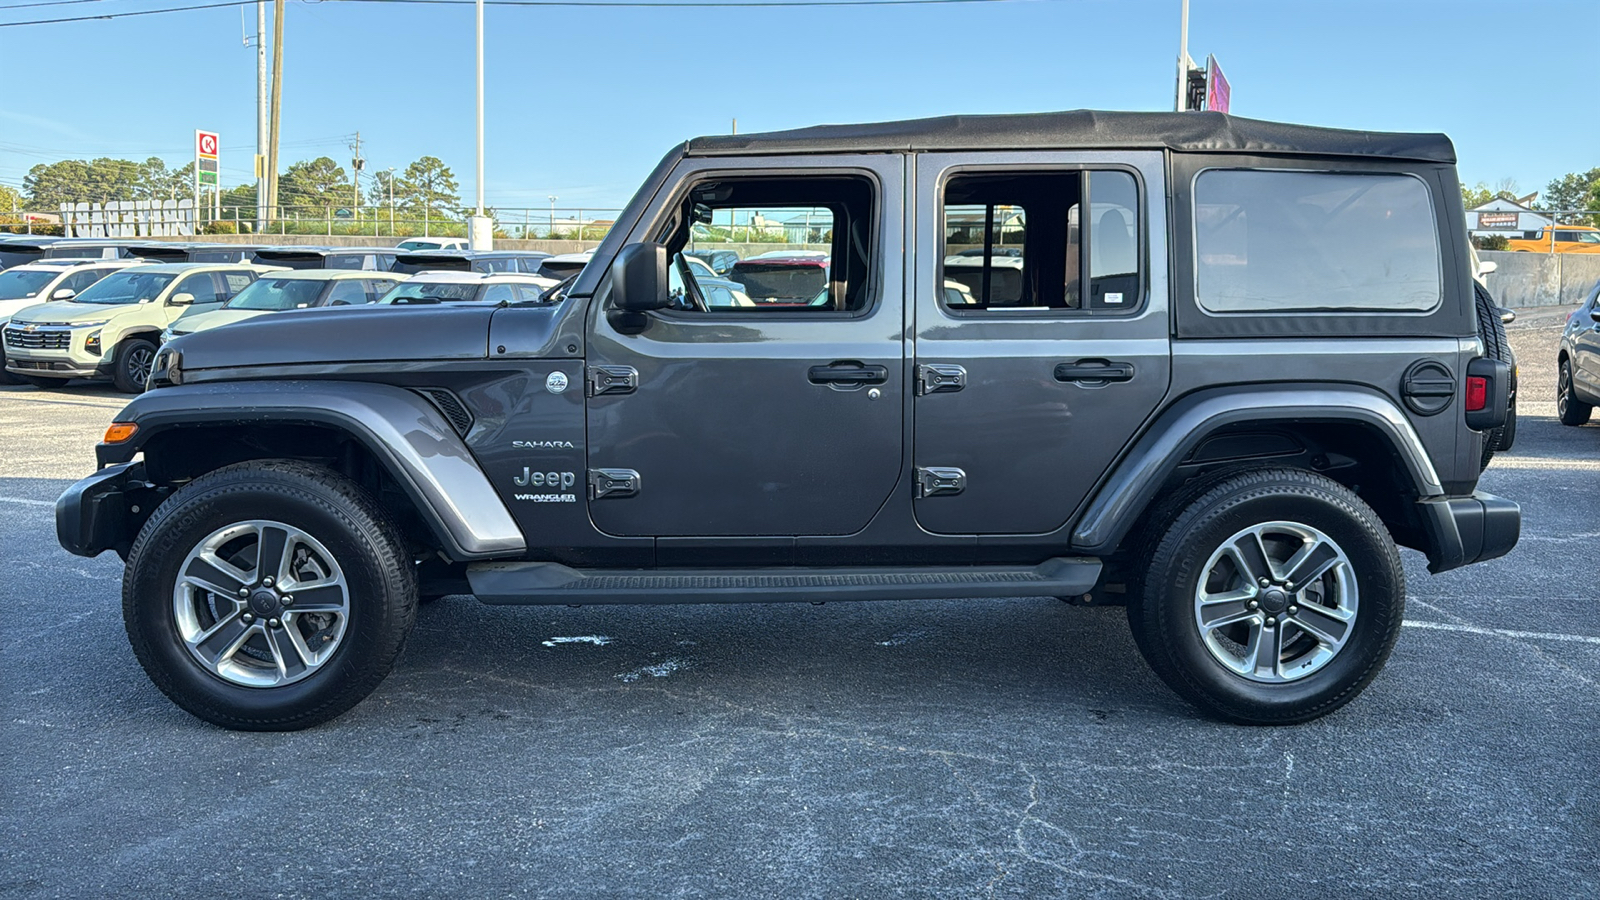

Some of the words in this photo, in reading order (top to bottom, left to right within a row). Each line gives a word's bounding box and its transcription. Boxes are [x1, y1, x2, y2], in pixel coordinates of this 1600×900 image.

[512, 440, 574, 449] SAHARA
[513, 466, 575, 491] Jeep
[513, 493, 576, 501] WRANGLER
